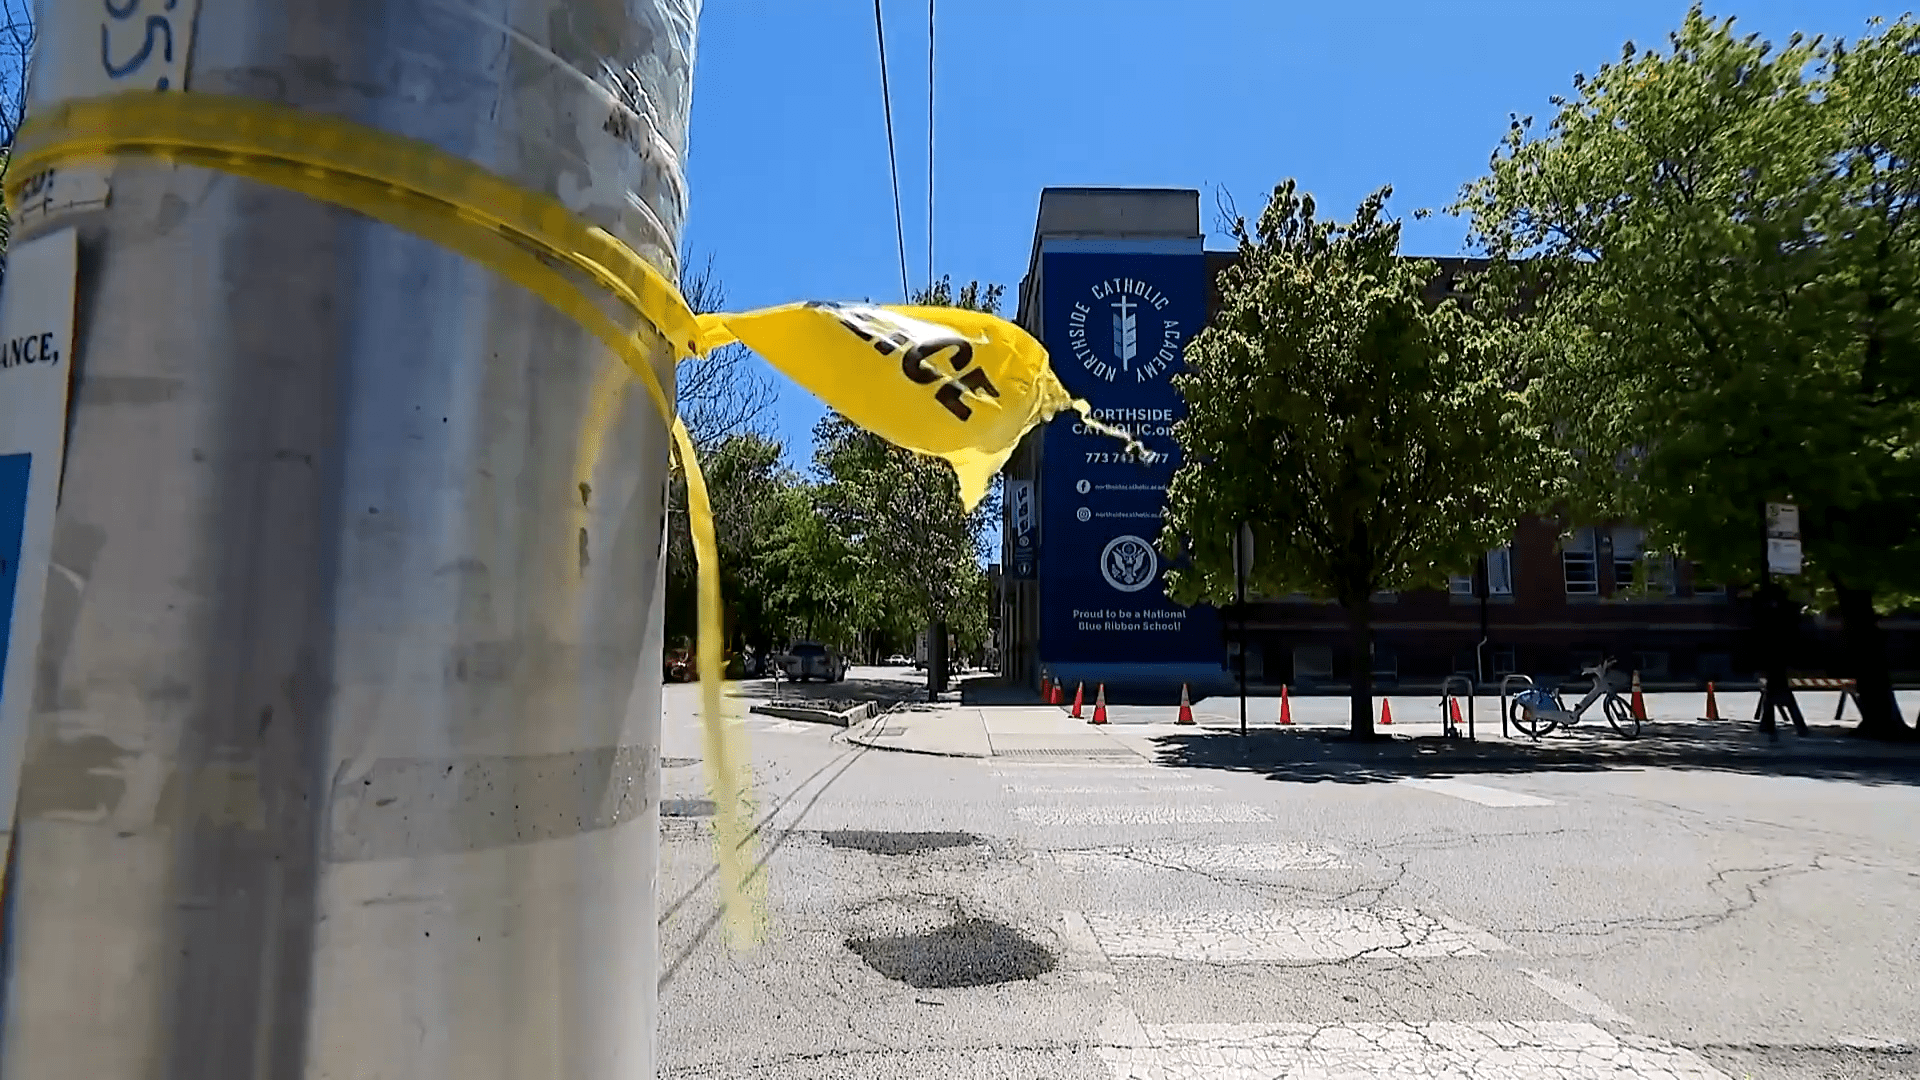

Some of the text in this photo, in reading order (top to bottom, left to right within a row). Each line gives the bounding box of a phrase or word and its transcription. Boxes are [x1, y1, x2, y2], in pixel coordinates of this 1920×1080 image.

[1069, 277, 1181, 384] NORTHSIDE CATHOLIC ACADEMY
[1085, 452, 1109, 464] 773
[1072, 608, 1187, 619] Proud to be a National
[1078, 620, 1181, 631] Blue Ribbon School!
